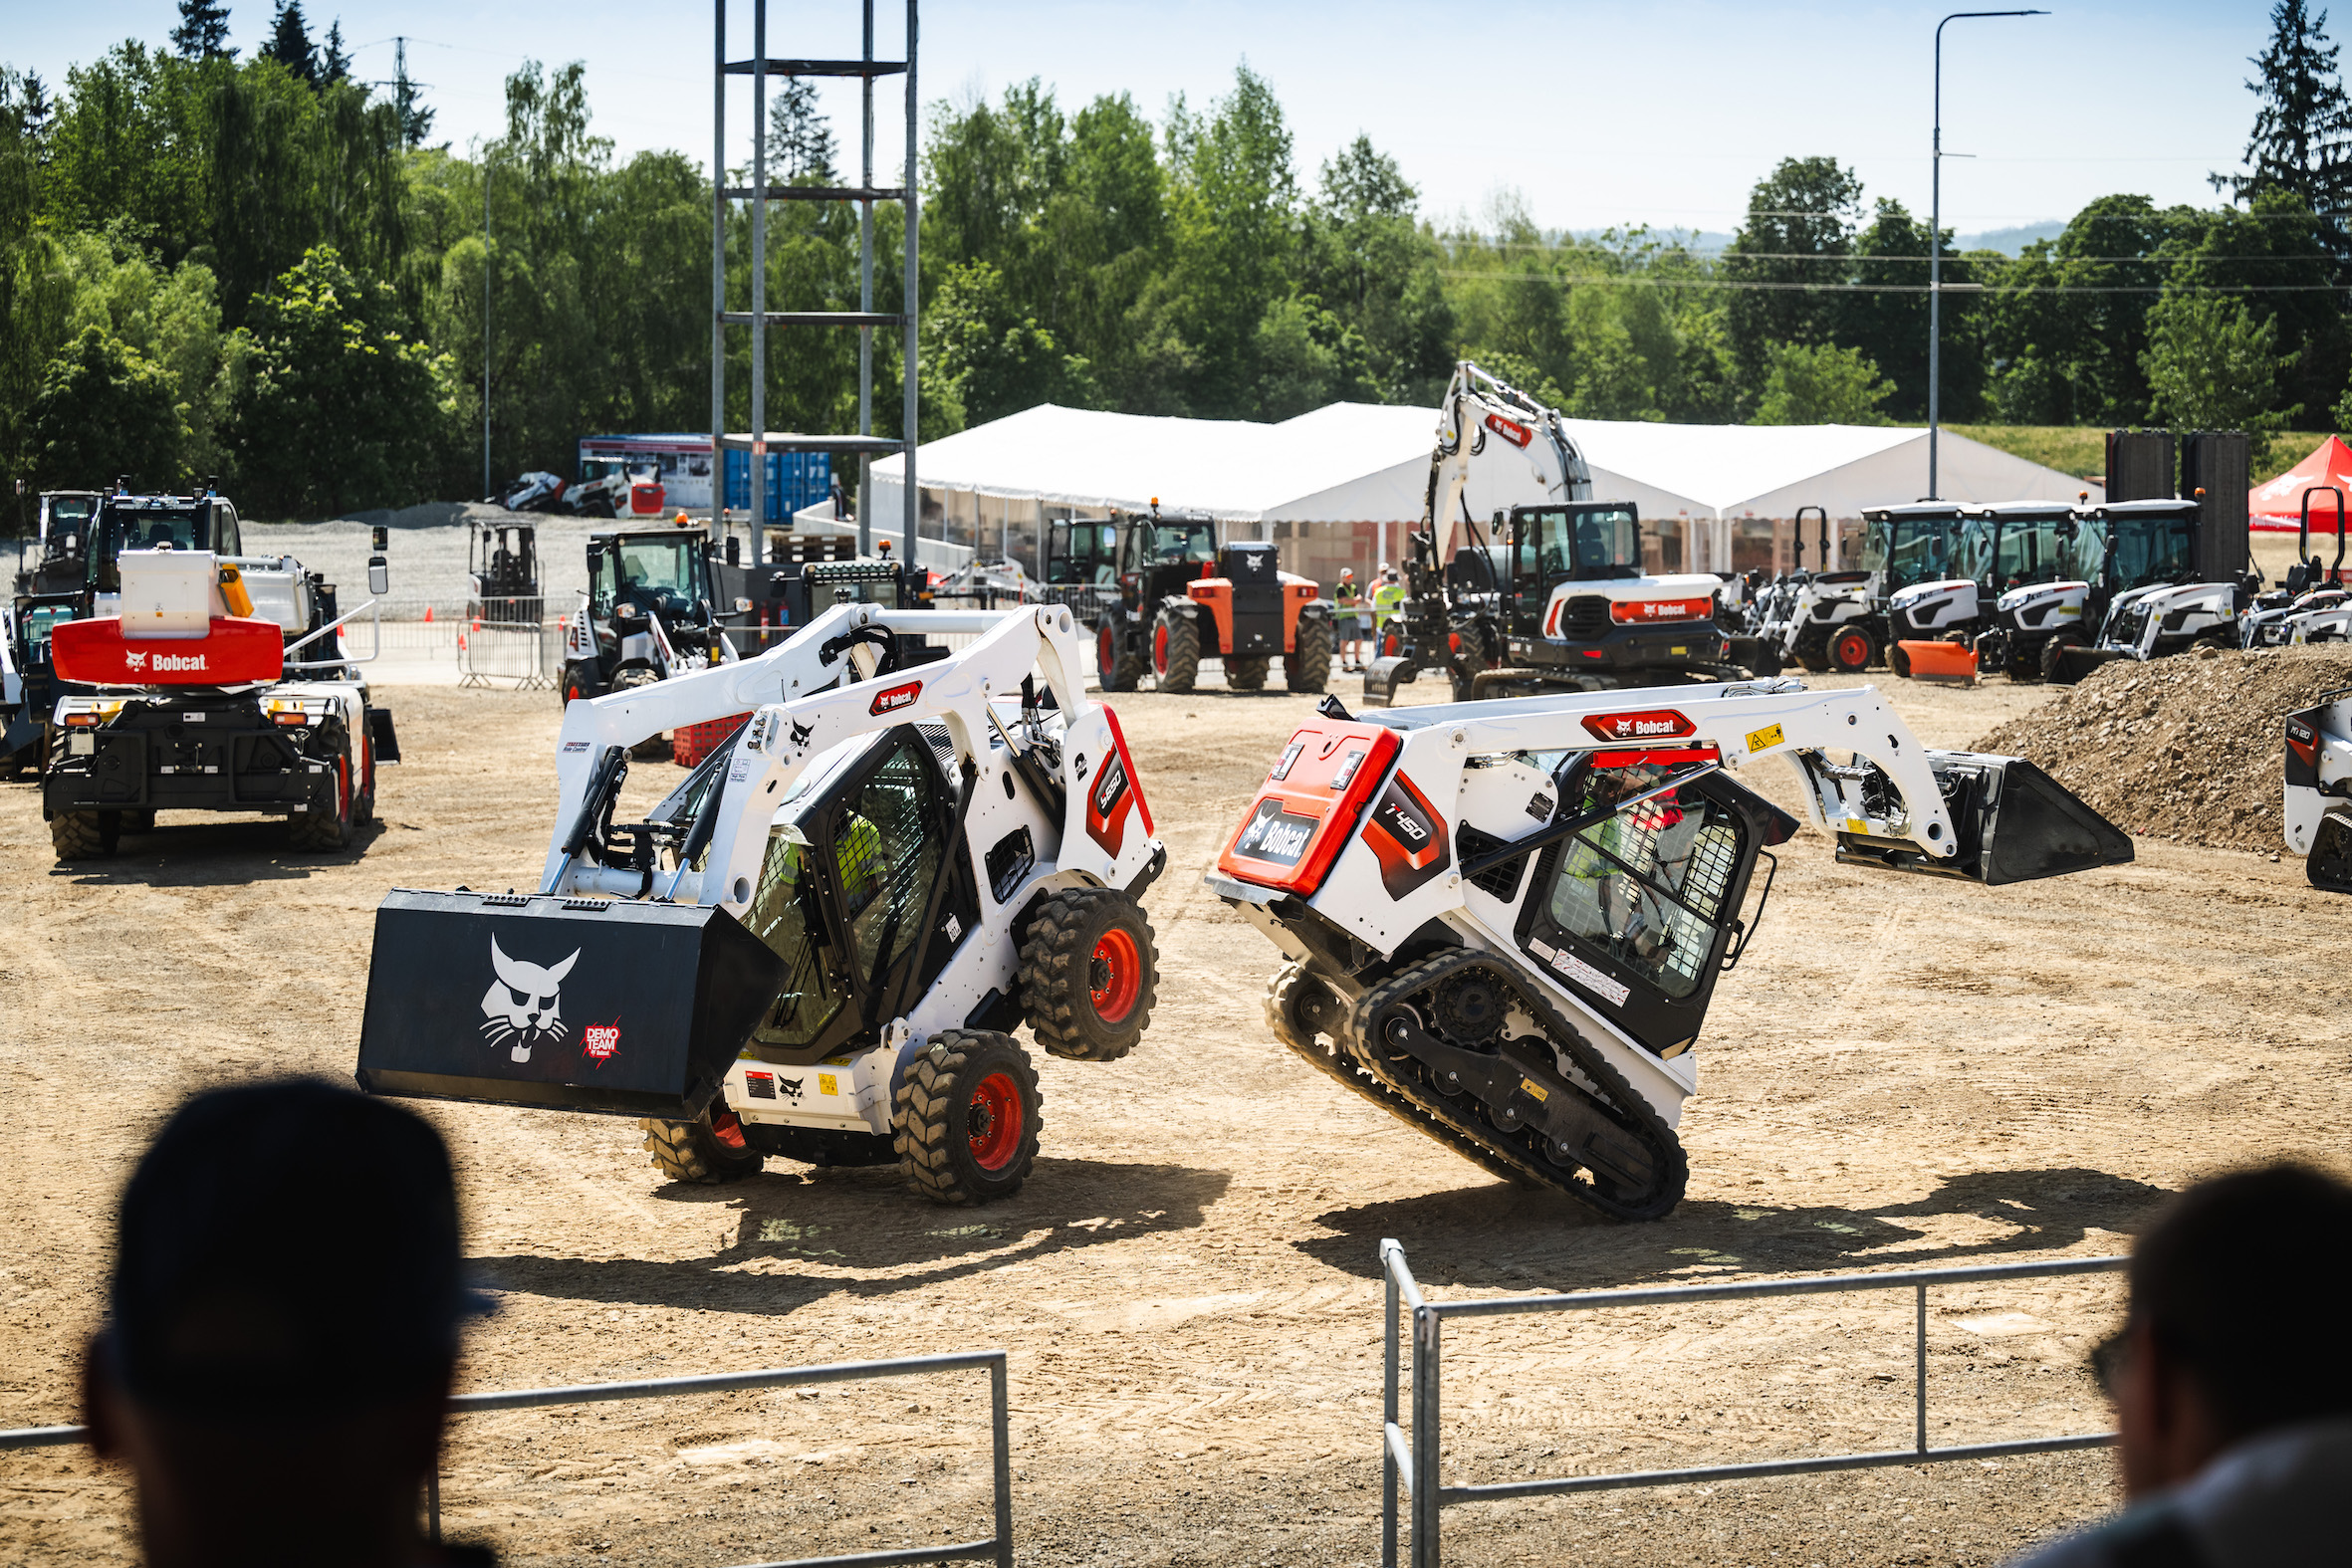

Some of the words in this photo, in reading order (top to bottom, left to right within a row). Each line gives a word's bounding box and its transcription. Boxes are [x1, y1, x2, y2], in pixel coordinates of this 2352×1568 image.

[1503, 424, 1522, 442] Bobcat
[1657, 603, 1686, 616] Bobcat
[152, 654, 206, 671] Bobcat
[890, 691, 911, 707] Bobcat
[1635, 720, 1674, 735] Bobcat
[1100, 770, 1121, 809] S650
[1385, 802, 1427, 840] T450
[1259, 820, 1311, 857] Bobcat
[588, 1028, 618, 1039] DEMO
[588, 1039, 615, 1050] TEAM
